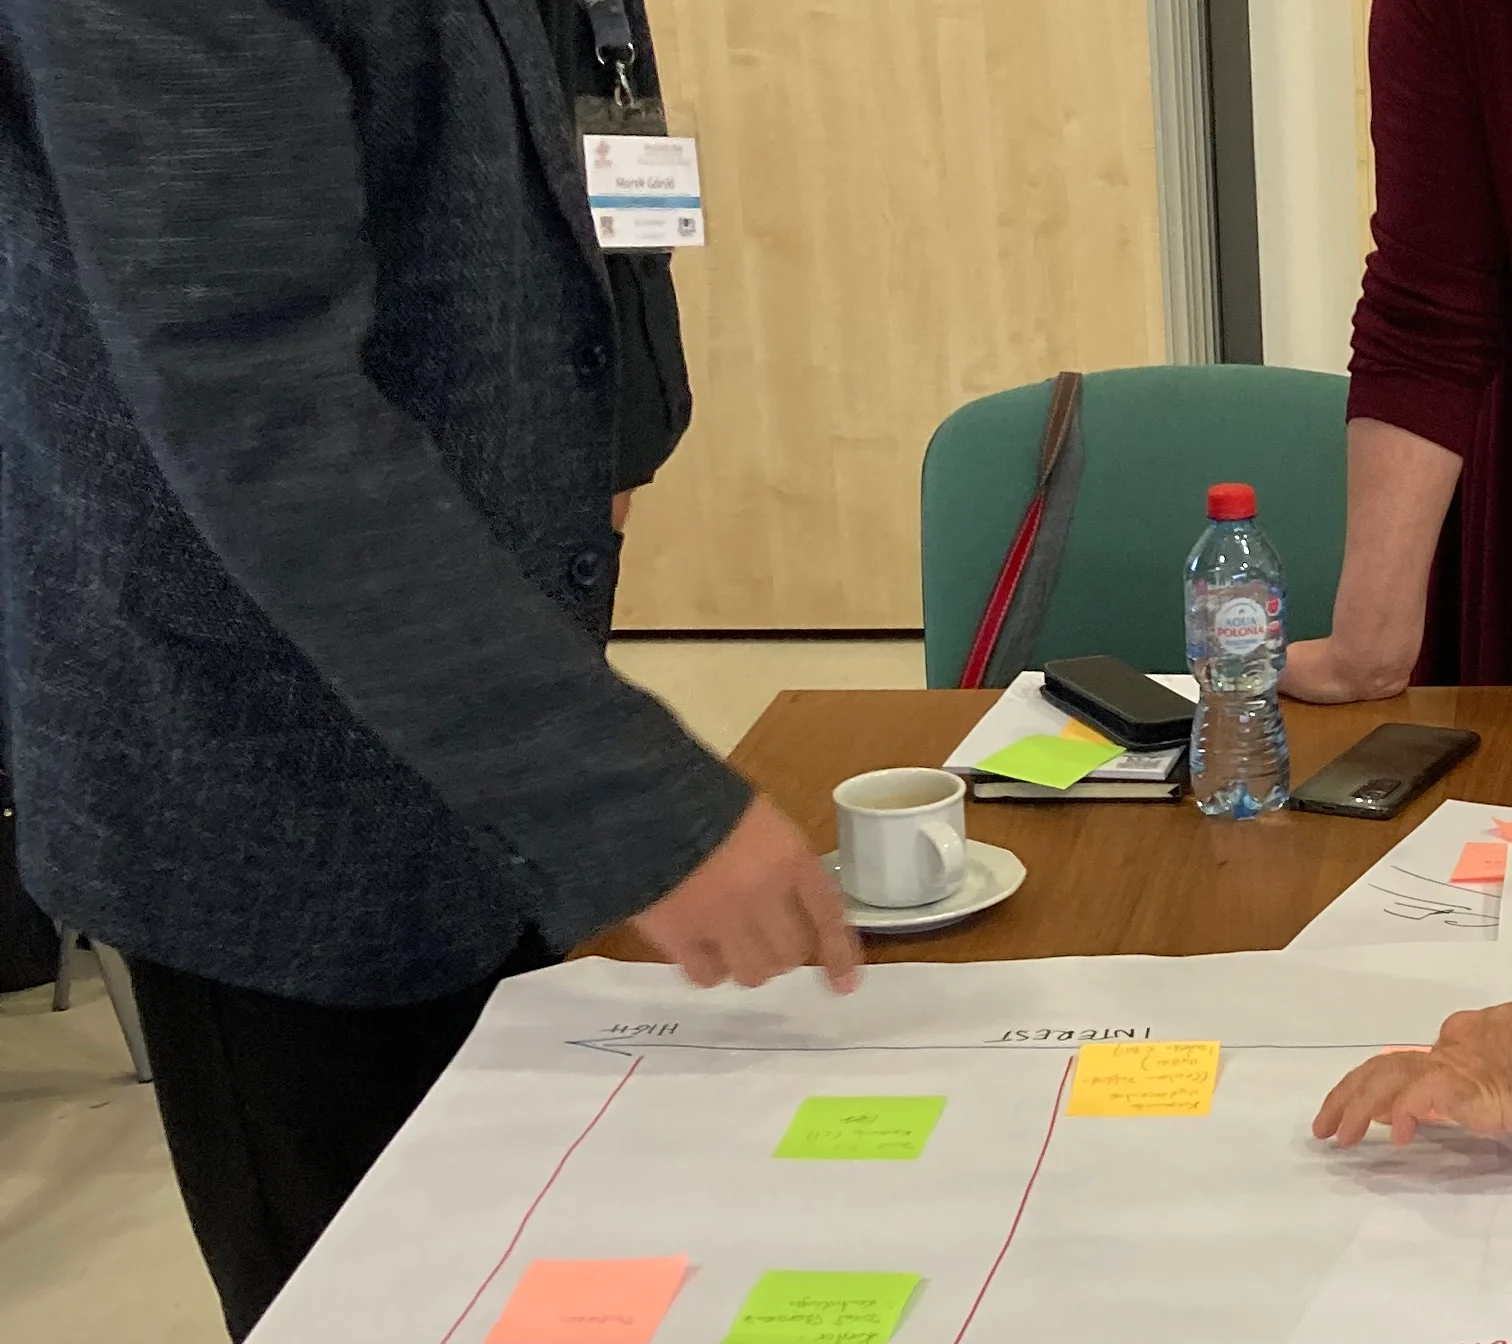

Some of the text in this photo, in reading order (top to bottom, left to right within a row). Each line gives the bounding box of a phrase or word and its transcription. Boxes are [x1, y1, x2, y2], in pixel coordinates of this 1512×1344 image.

[1217, 625, 1265, 638] POLONIA
[603, 1021, 679, 1037] HIGH
[984, 1025, 1152, 1043] INTEREST
